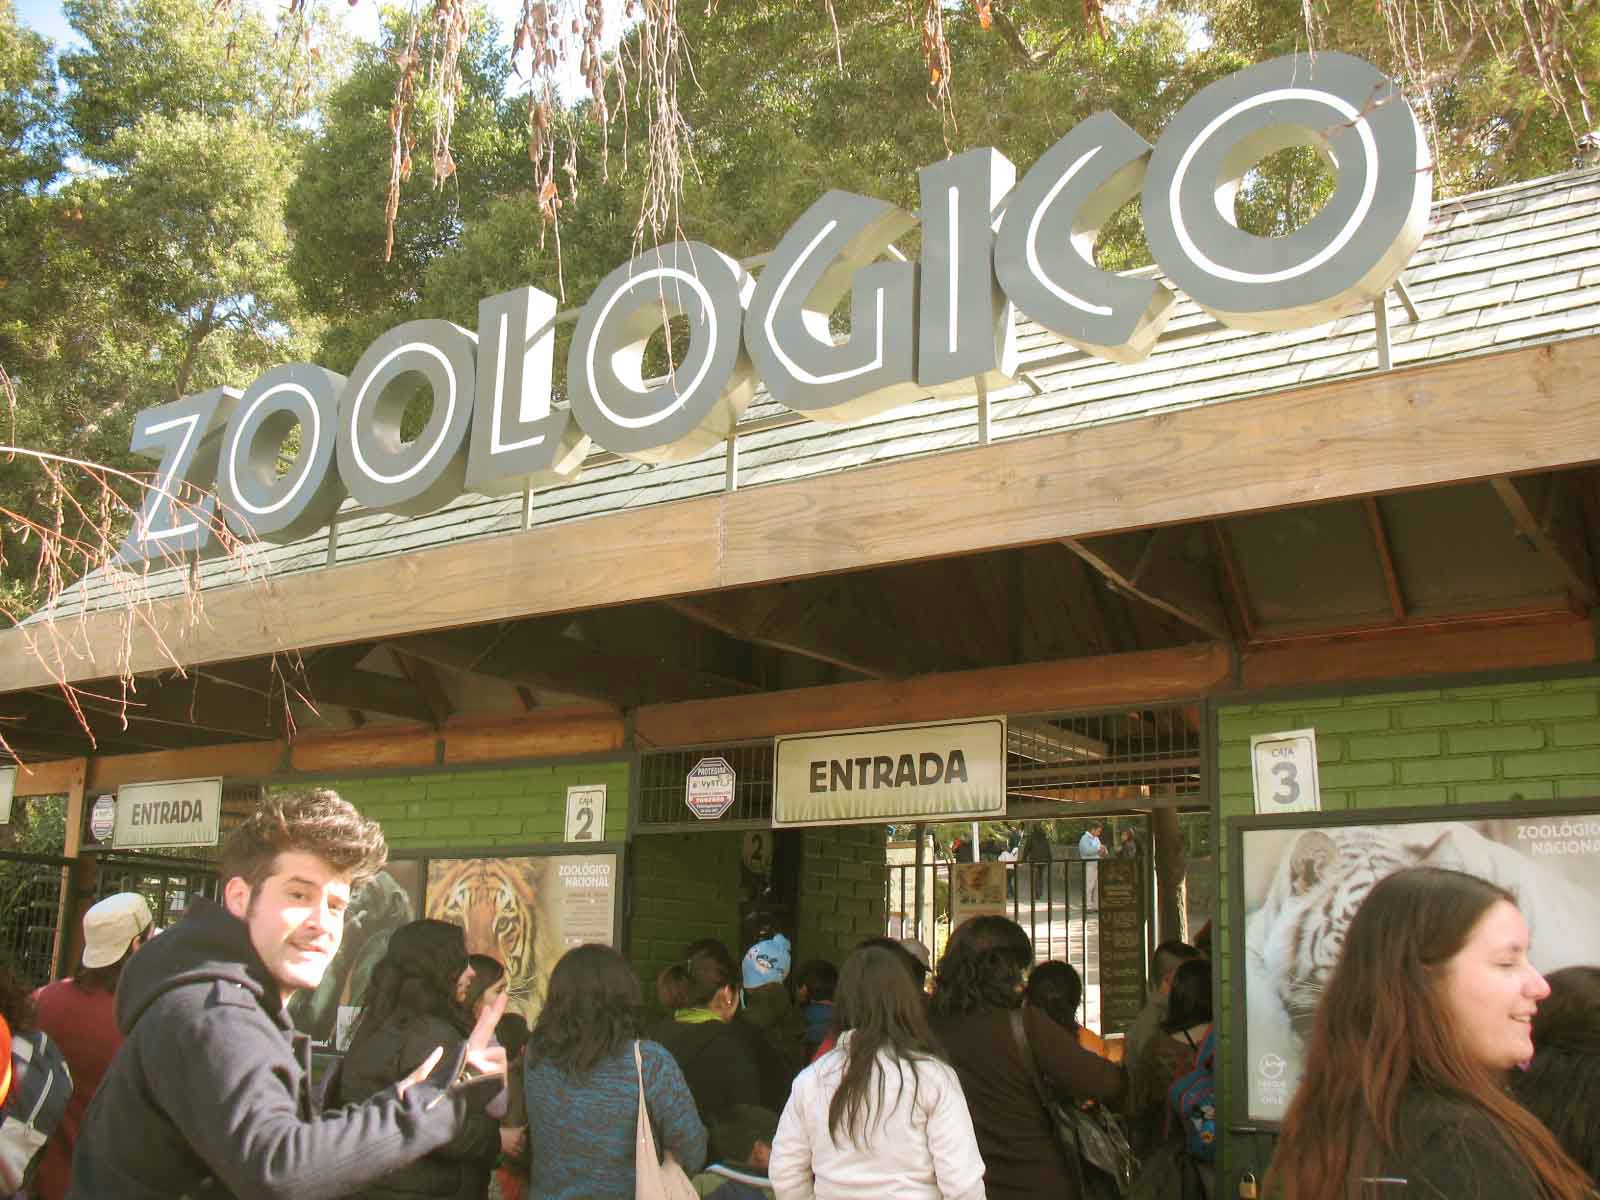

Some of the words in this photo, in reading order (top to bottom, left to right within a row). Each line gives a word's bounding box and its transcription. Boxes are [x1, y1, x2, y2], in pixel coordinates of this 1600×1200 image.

[110, 51, 1431, 563] ZOOLOGICO
[809, 749, 968, 793] ENTRADA
[1271, 761, 1300, 805] 3
[131, 799, 203, 826] ENTRADA
[574, 808, 594, 841] 2
[565, 876, 609, 888] NACIONAL
